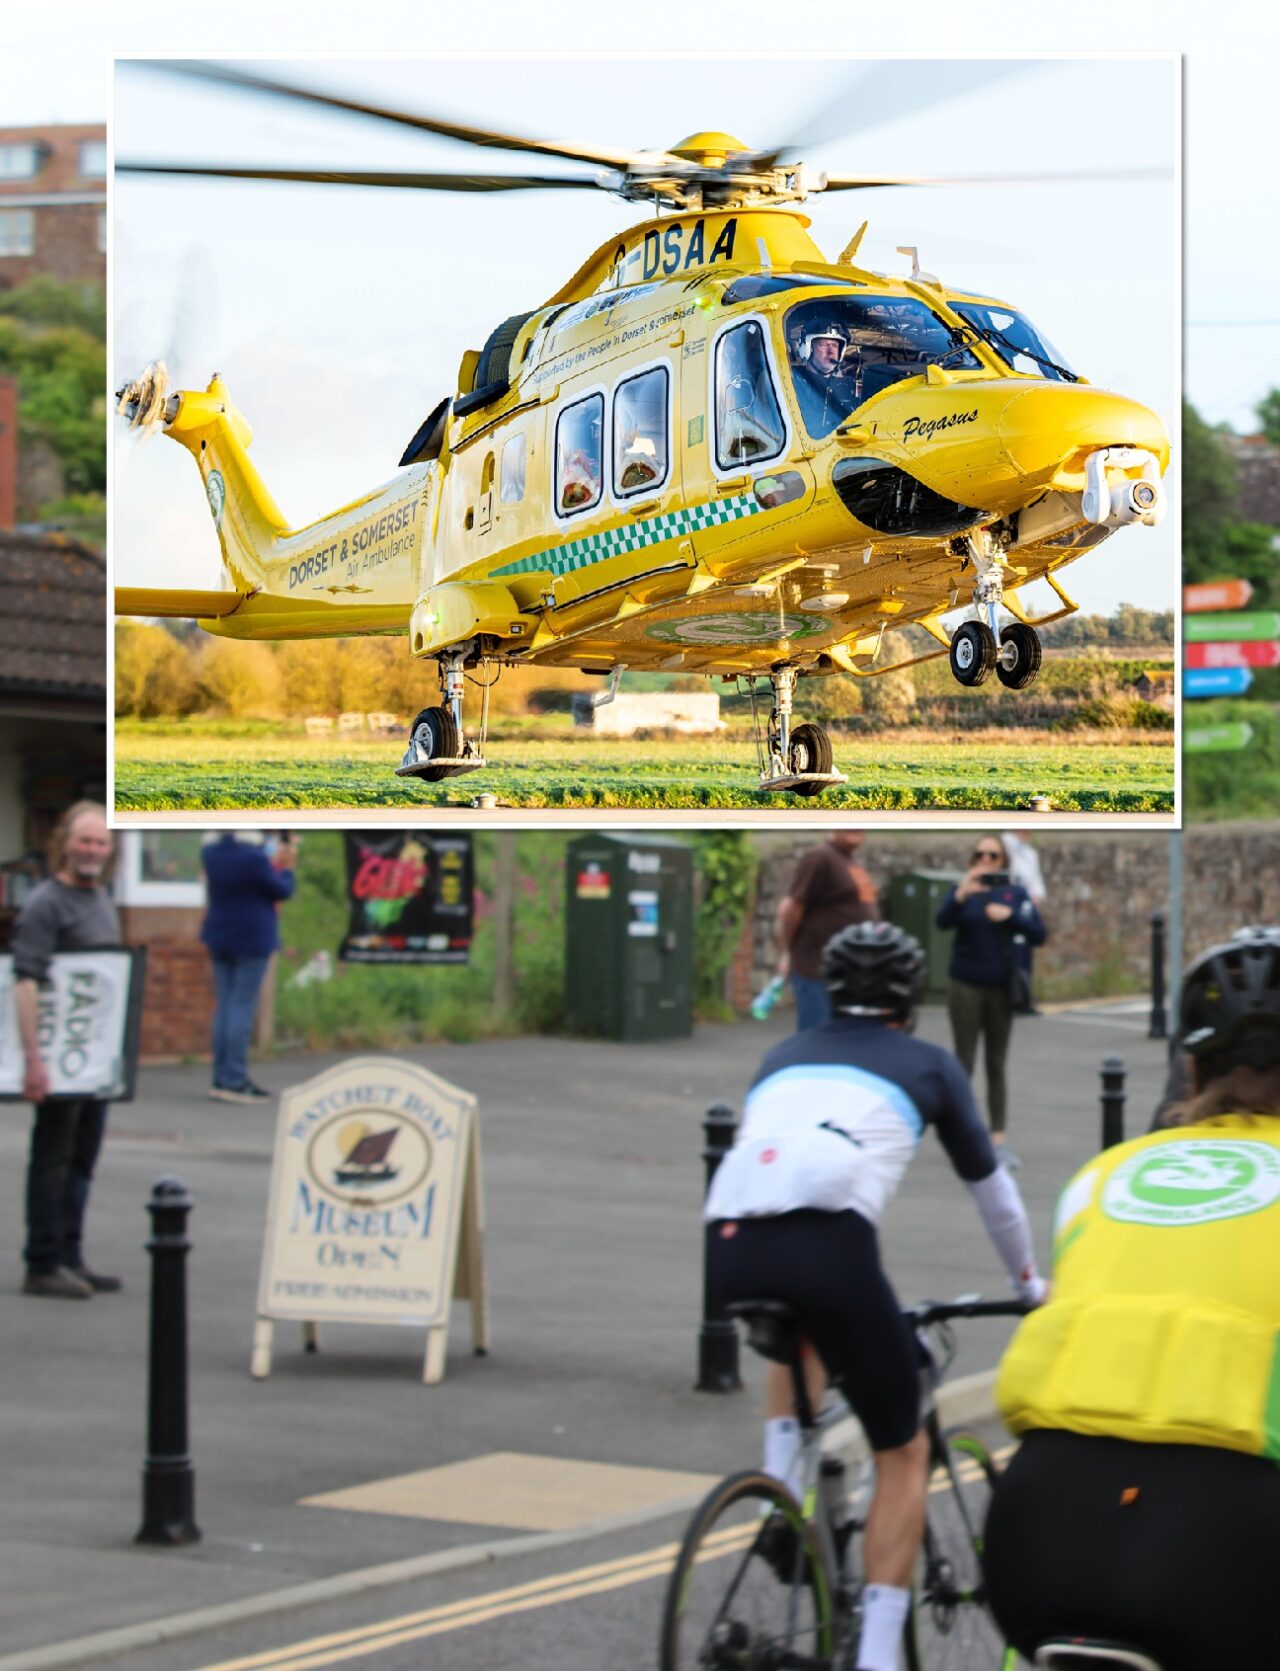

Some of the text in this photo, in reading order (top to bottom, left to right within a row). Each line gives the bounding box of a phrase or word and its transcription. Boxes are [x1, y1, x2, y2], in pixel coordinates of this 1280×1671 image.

[588, 338, 611, 360] People
[622, 324, 647, 344] Dorset
[903, 409, 978, 443] Pegasus
[289, 500, 419, 590] DORSET & SOMERSET
[347, 533, 416, 580] Air Ambulance
[58, 971, 98, 1080] RADIO
[289, 1177, 437, 1239] MUSEUM
